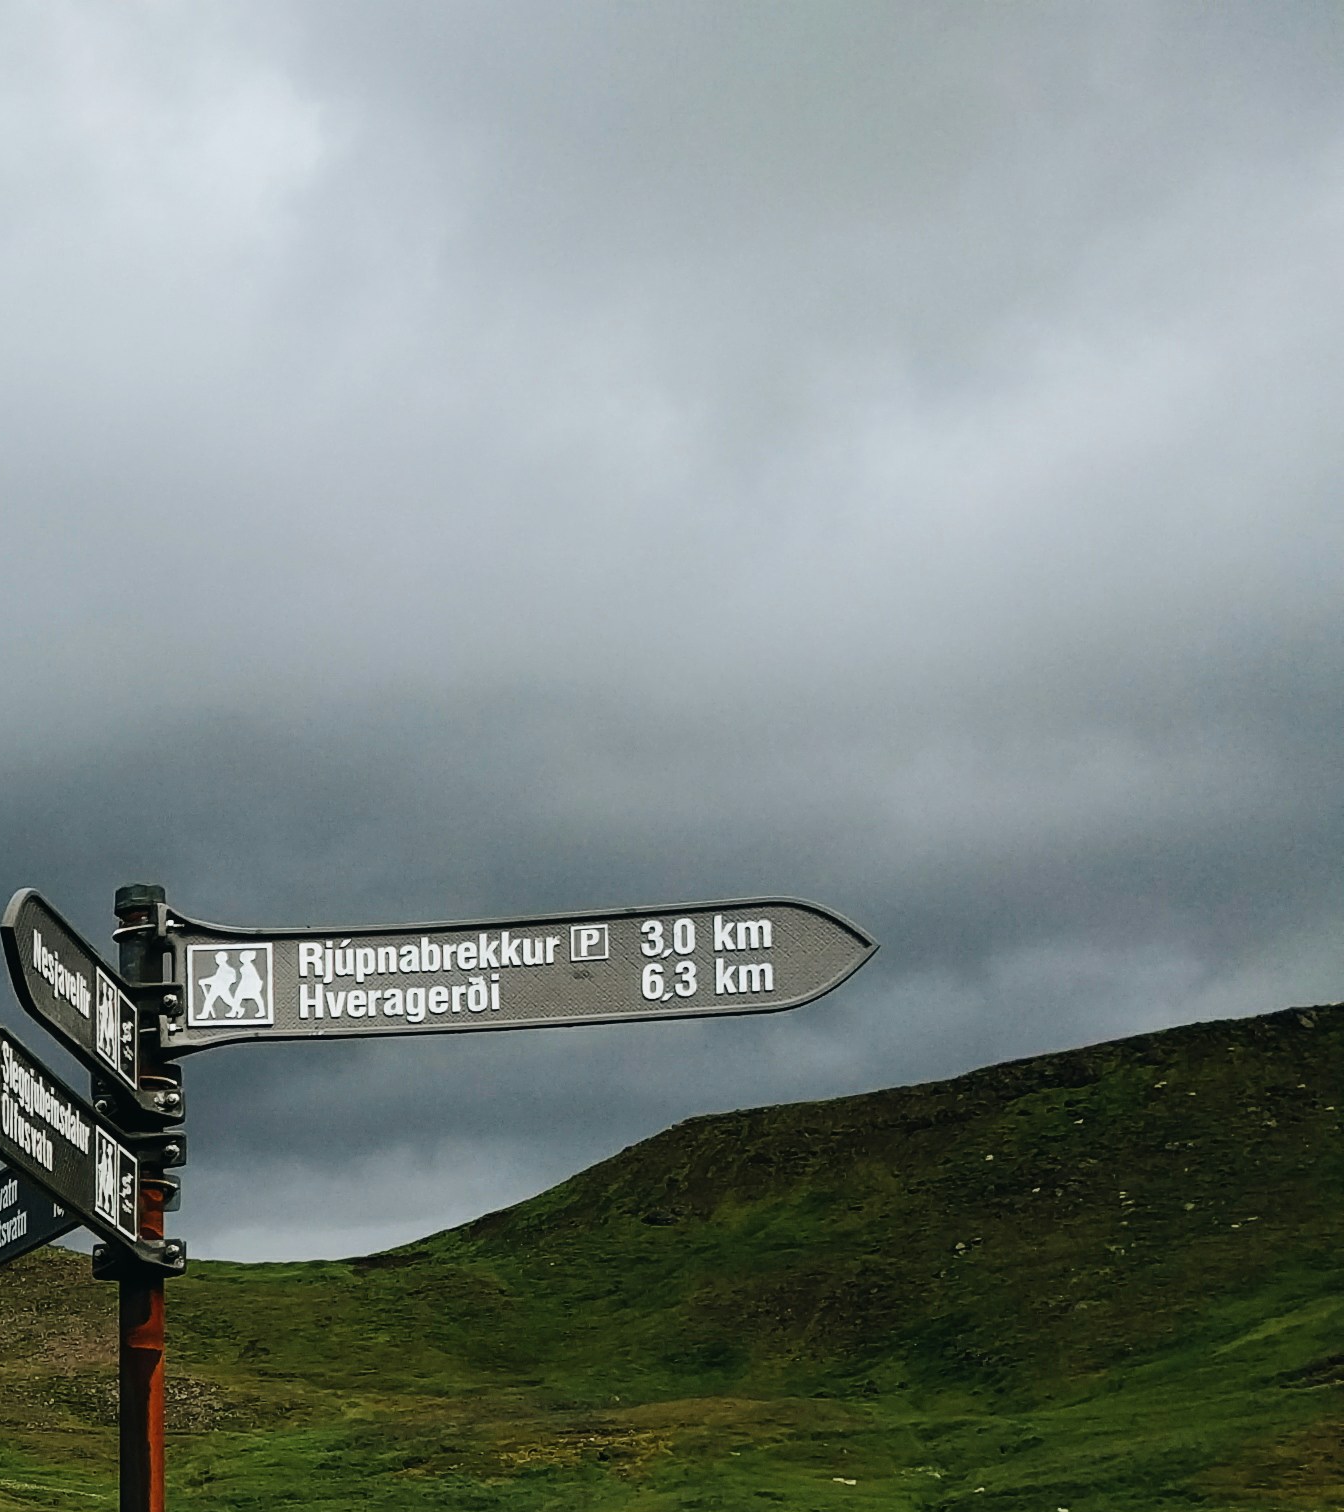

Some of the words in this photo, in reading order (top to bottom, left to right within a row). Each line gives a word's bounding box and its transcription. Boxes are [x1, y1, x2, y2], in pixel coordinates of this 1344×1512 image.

[33, 928, 91, 1019] Nesjavellir
[298, 931, 561, 983] Rjúpnabrekkur
[580, 928, 600, 957] P
[640, 917, 696, 959] 3,0
[713, 914, 773, 951] km
[298, 973, 501, 1022] Hveragerði
[641, 960, 698, 1002] 6,3
[715, 957, 774, 995] km
[0, 1040, 91, 1155] Sleggjubeinsdalur
[1, 1082, 53, 1172] Ölfusvatn
